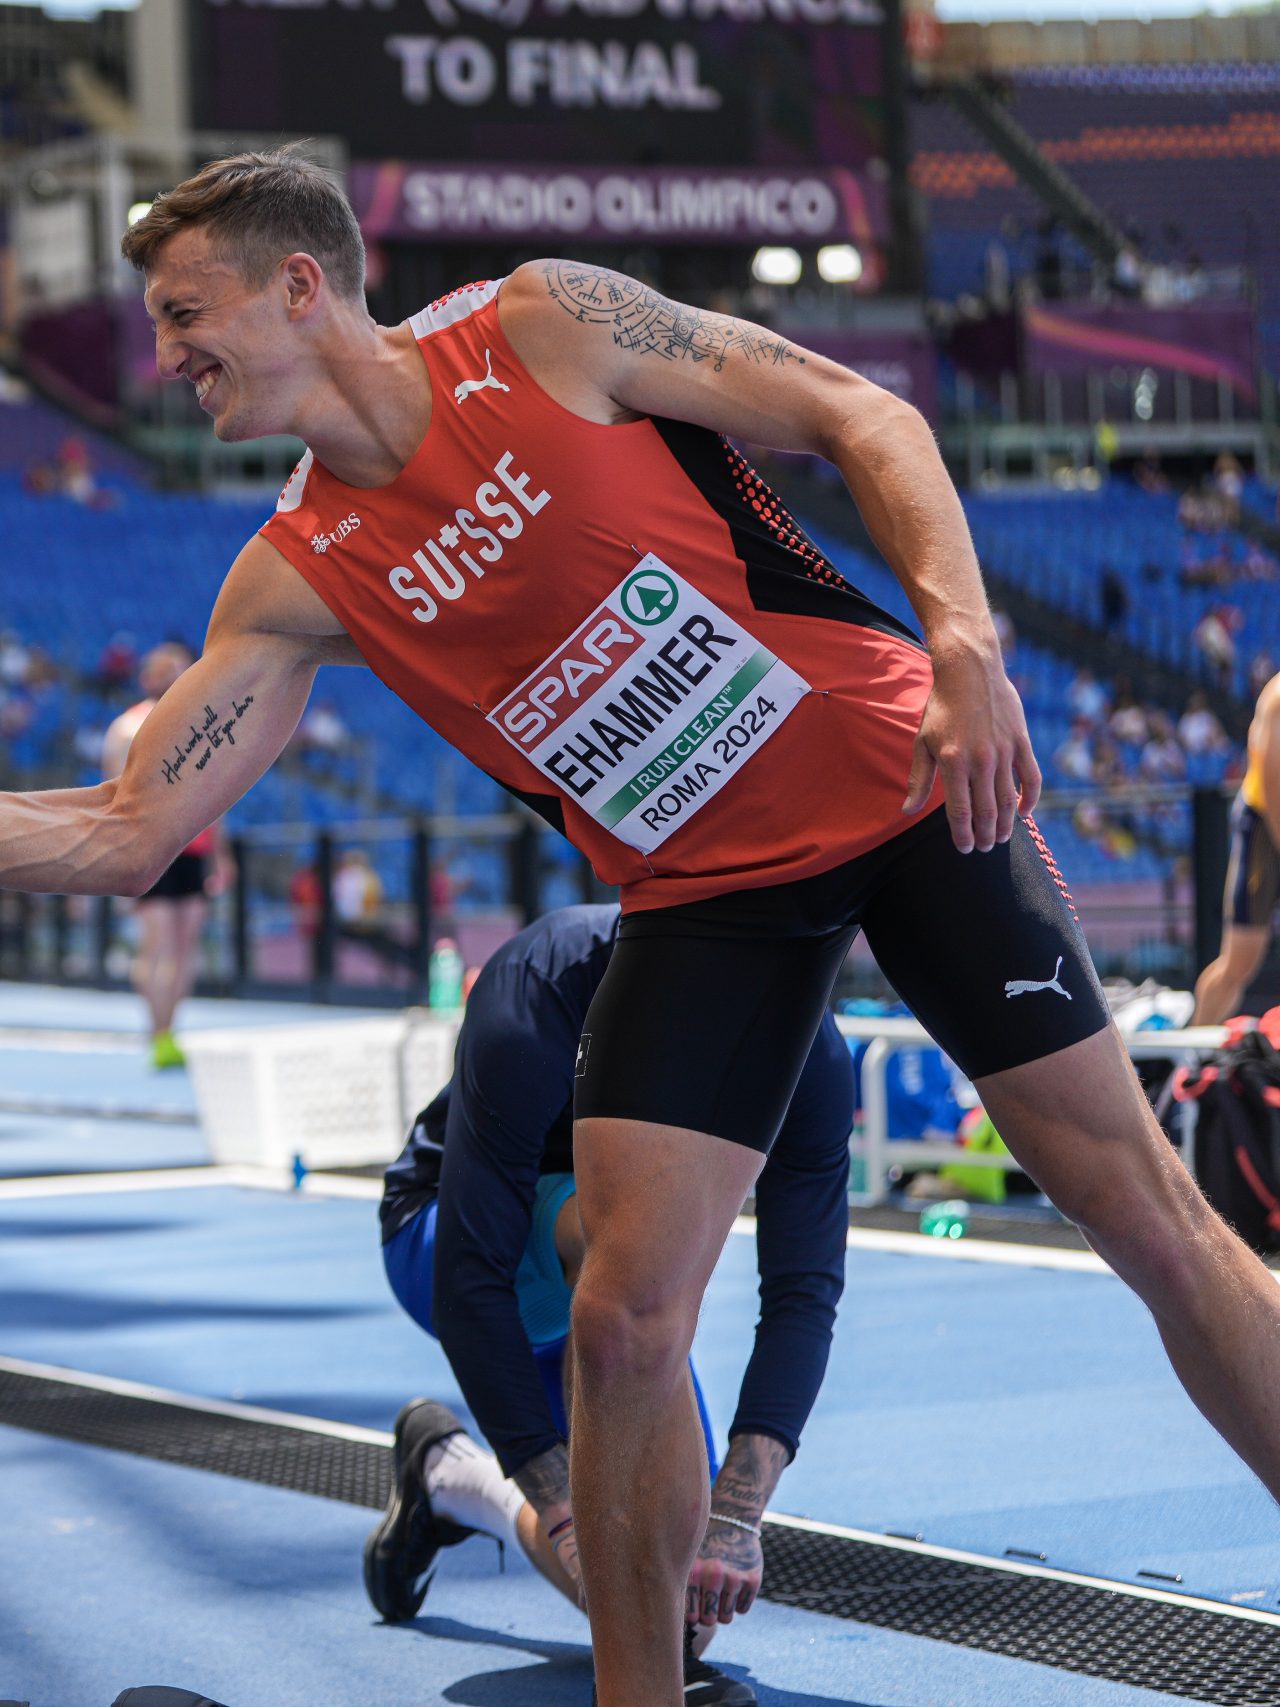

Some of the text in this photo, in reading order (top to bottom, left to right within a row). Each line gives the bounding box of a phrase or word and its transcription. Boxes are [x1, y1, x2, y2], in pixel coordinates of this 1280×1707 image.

[384, 36, 721, 111] TO FINAL
[403, 171, 838, 236] STADIO OLIMPICO
[328, 512, 362, 544] UBS
[504, 618, 635, 743] SPAR
[543, 614, 738, 799] EHAMMER
[161, 704, 218, 784] Hard work will
[629, 782, 643, 797] I
[637, 752, 677, 791] RUN
[640, 695, 778, 832] ROMA 2024
